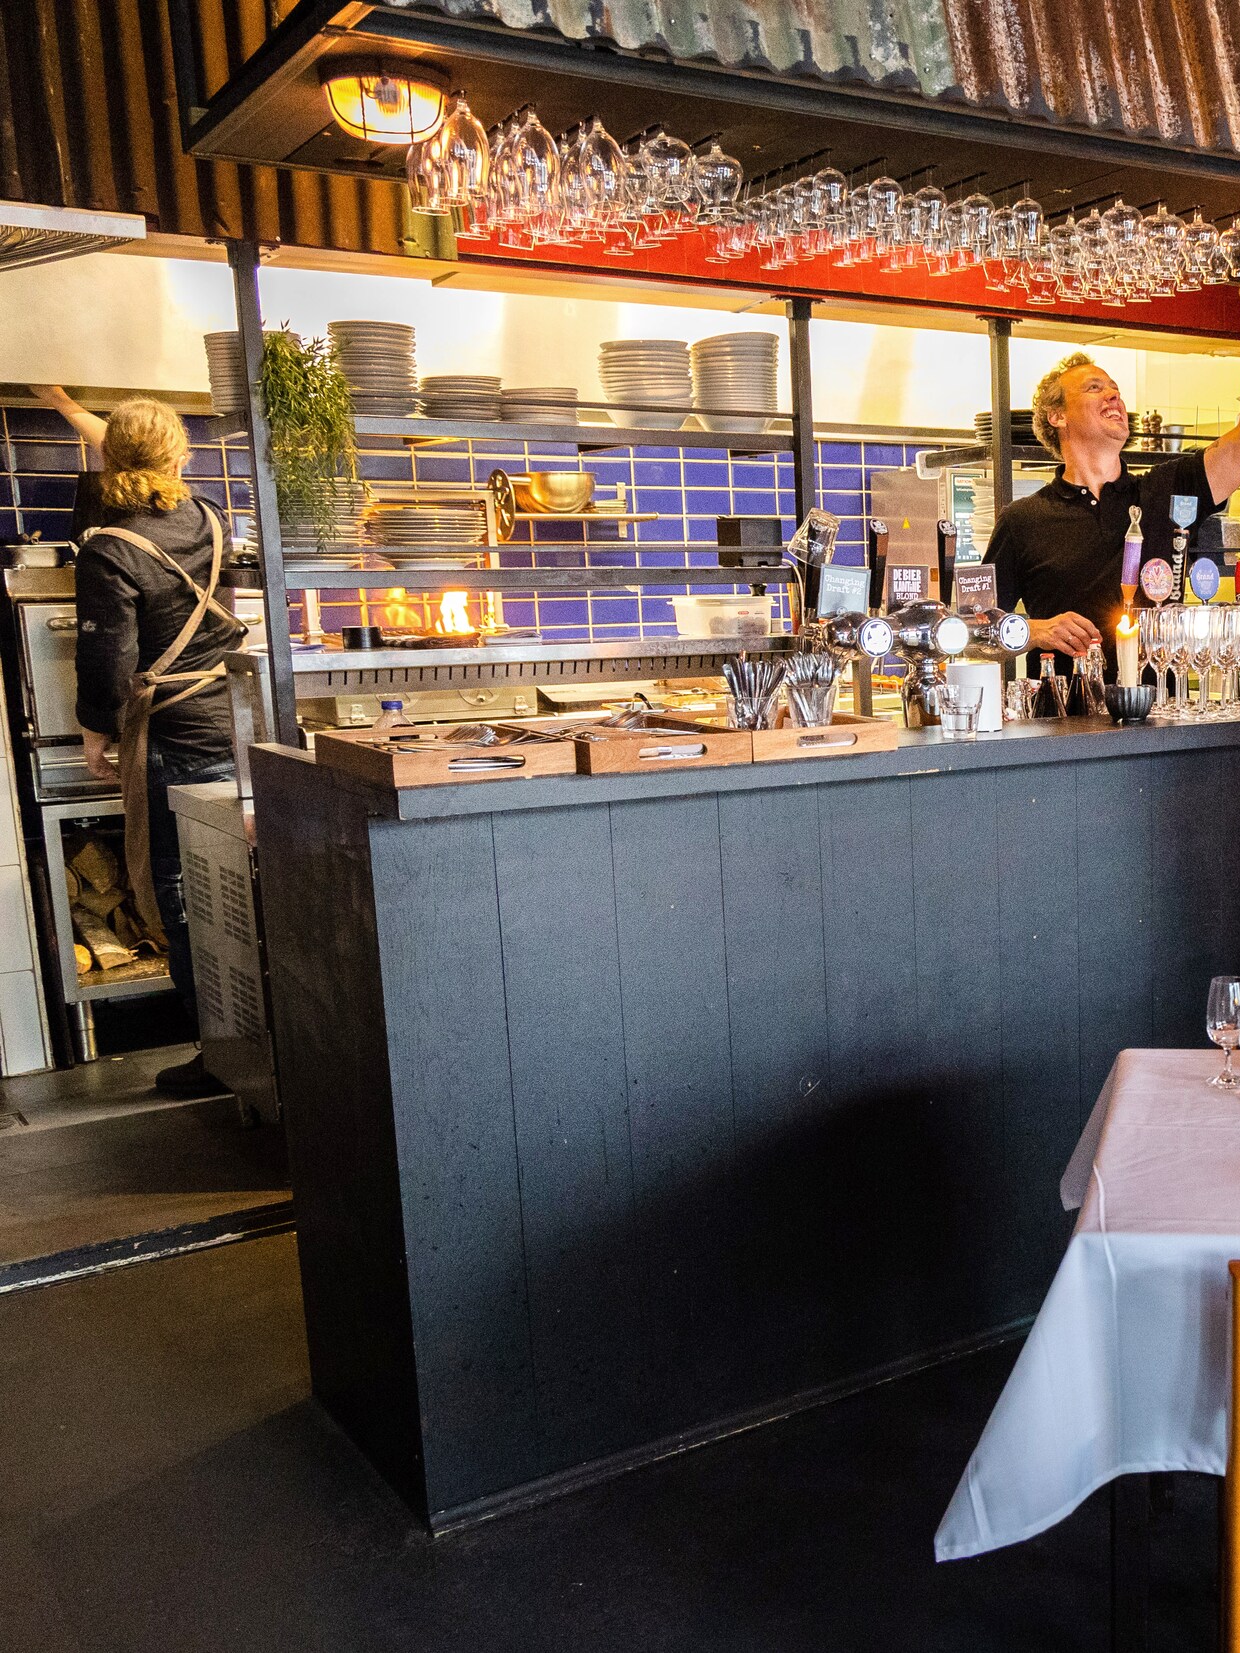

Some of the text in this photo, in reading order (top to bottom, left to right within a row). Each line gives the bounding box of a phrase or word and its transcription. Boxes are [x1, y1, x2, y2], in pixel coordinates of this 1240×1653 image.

[825, 575, 865, 588] Changing
[959, 575, 992, 585] Changing
[826, 584, 850, 594] Draft
[961, 584, 981, 593] Draft
